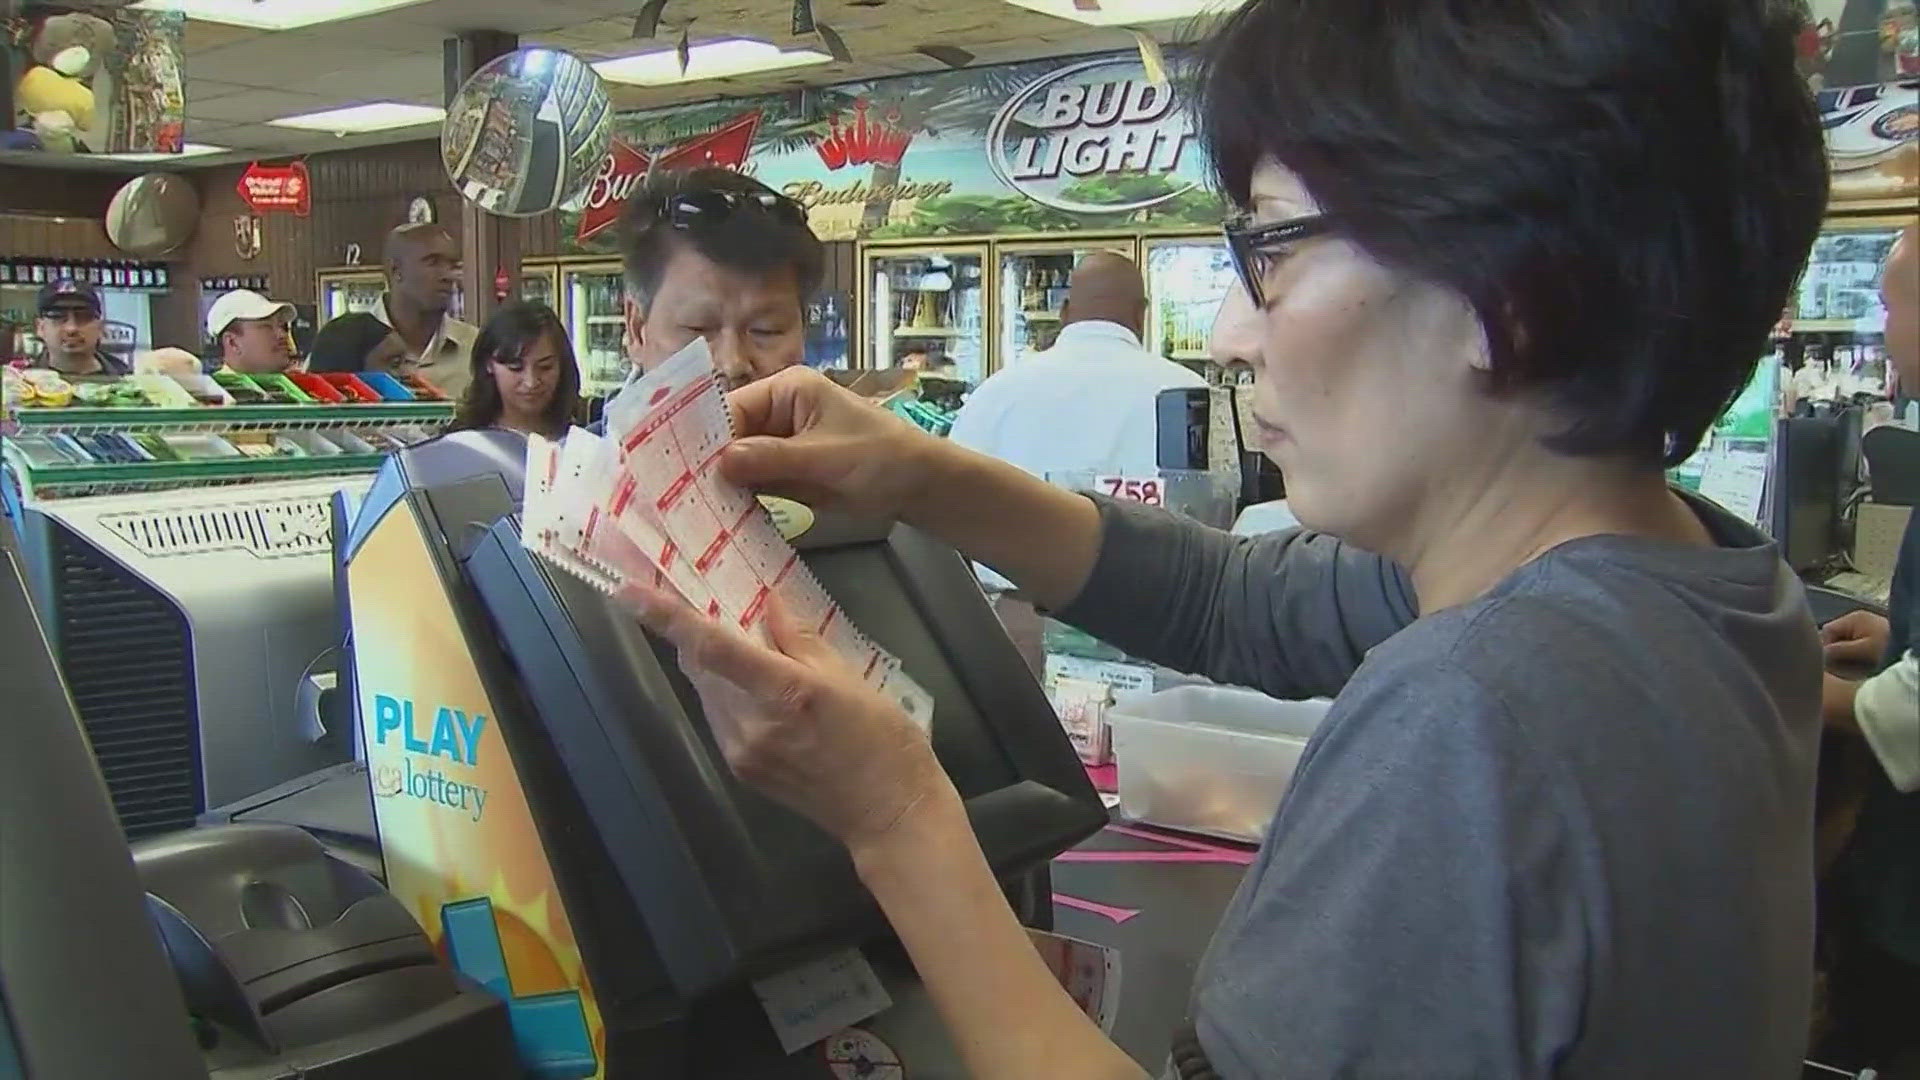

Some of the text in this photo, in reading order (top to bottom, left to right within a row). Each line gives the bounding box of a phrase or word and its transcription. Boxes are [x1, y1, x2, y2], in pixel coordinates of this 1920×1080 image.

[1040, 80, 1173, 129] BUD
[1013, 112, 1195, 180] LIGHT
[782, 178, 953, 209] Budweiser
[346, 243, 361, 265] 12
[1103, 479, 1160, 505] 758
[375, 694, 487, 766] PLAY
